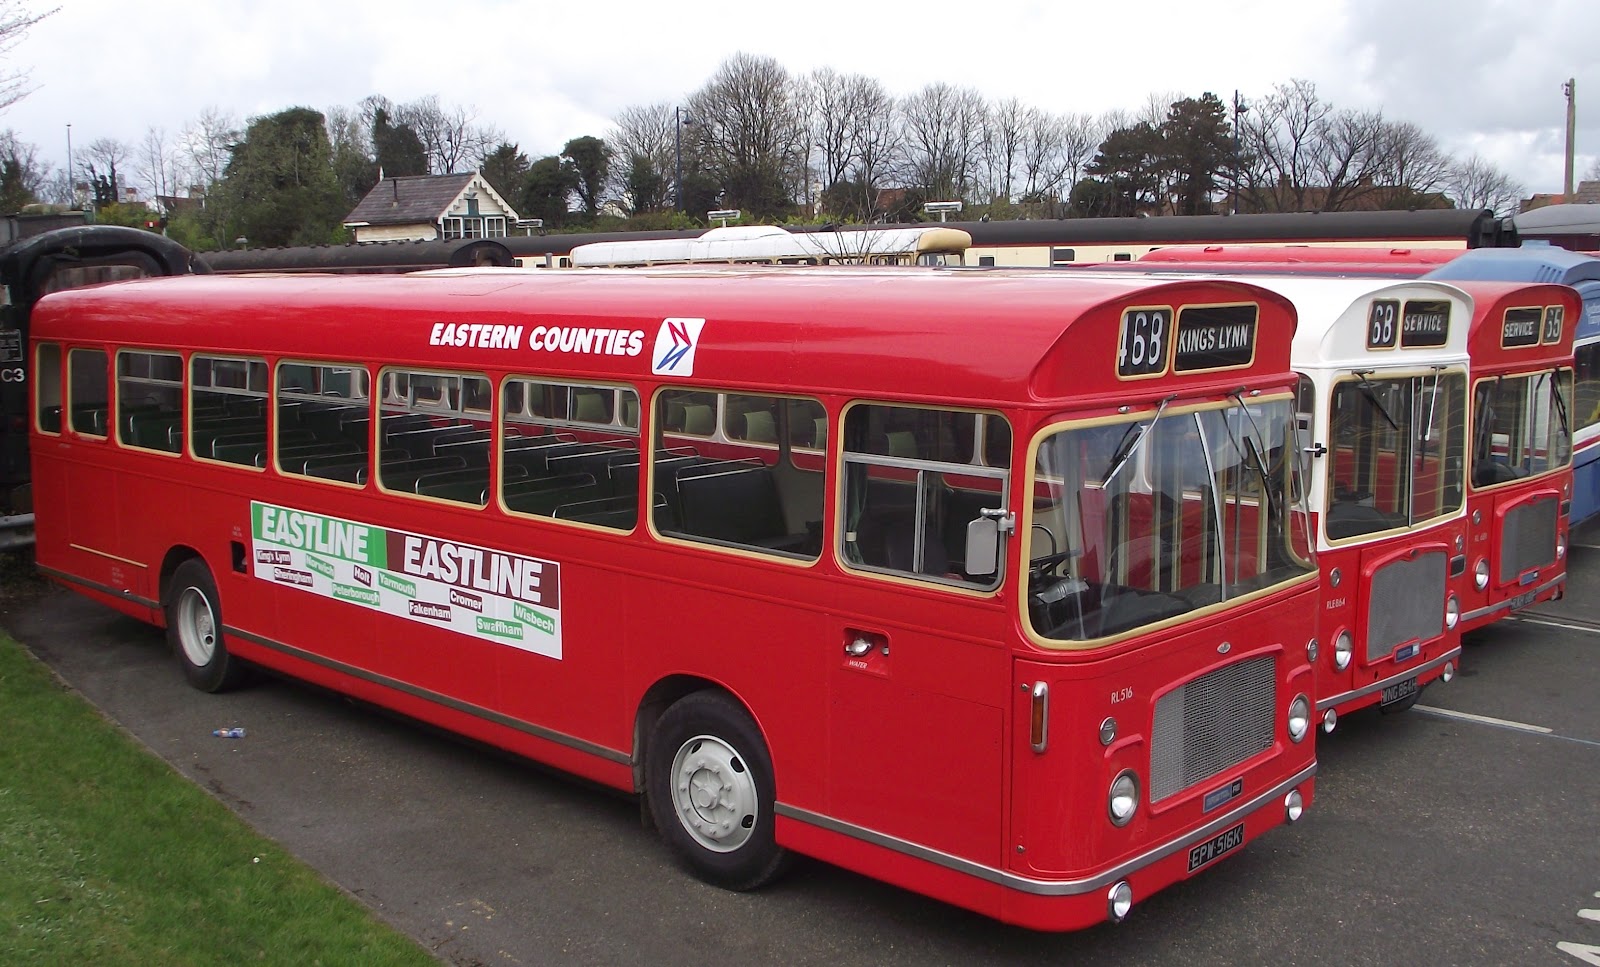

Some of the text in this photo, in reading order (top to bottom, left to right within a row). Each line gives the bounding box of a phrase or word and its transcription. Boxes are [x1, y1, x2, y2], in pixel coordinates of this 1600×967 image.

[1372, 304, 1394, 344] 68
[1404, 314, 1442, 332] SERVICE
[1504, 321, 1534, 338] SERVICE
[429, 323, 645, 356] EASTERN COUNTIES
[1178, 324, 1249, 353] KINGS LYNN
[1, 368, 25, 382] C3
[261, 506, 369, 563] EASTLINE
[256, 550, 291, 564] King's Lynn
[306, 554, 334, 576] Norwich
[274, 567, 313, 585] Sheringham
[354, 567, 371, 584] Holt
[403, 536, 543, 603] EASTLINE
[332, 585, 379, 604] Peterborough
[379, 573, 416, 597] Yarmouth
[409, 602, 451, 619] Fakenham
[450, 592, 482, 610] Cromer
[477, 618, 523, 637] Swaffham
[515, 604, 554, 634] Wisbech
[1191, 827, 1241, 868] EPW 516K
